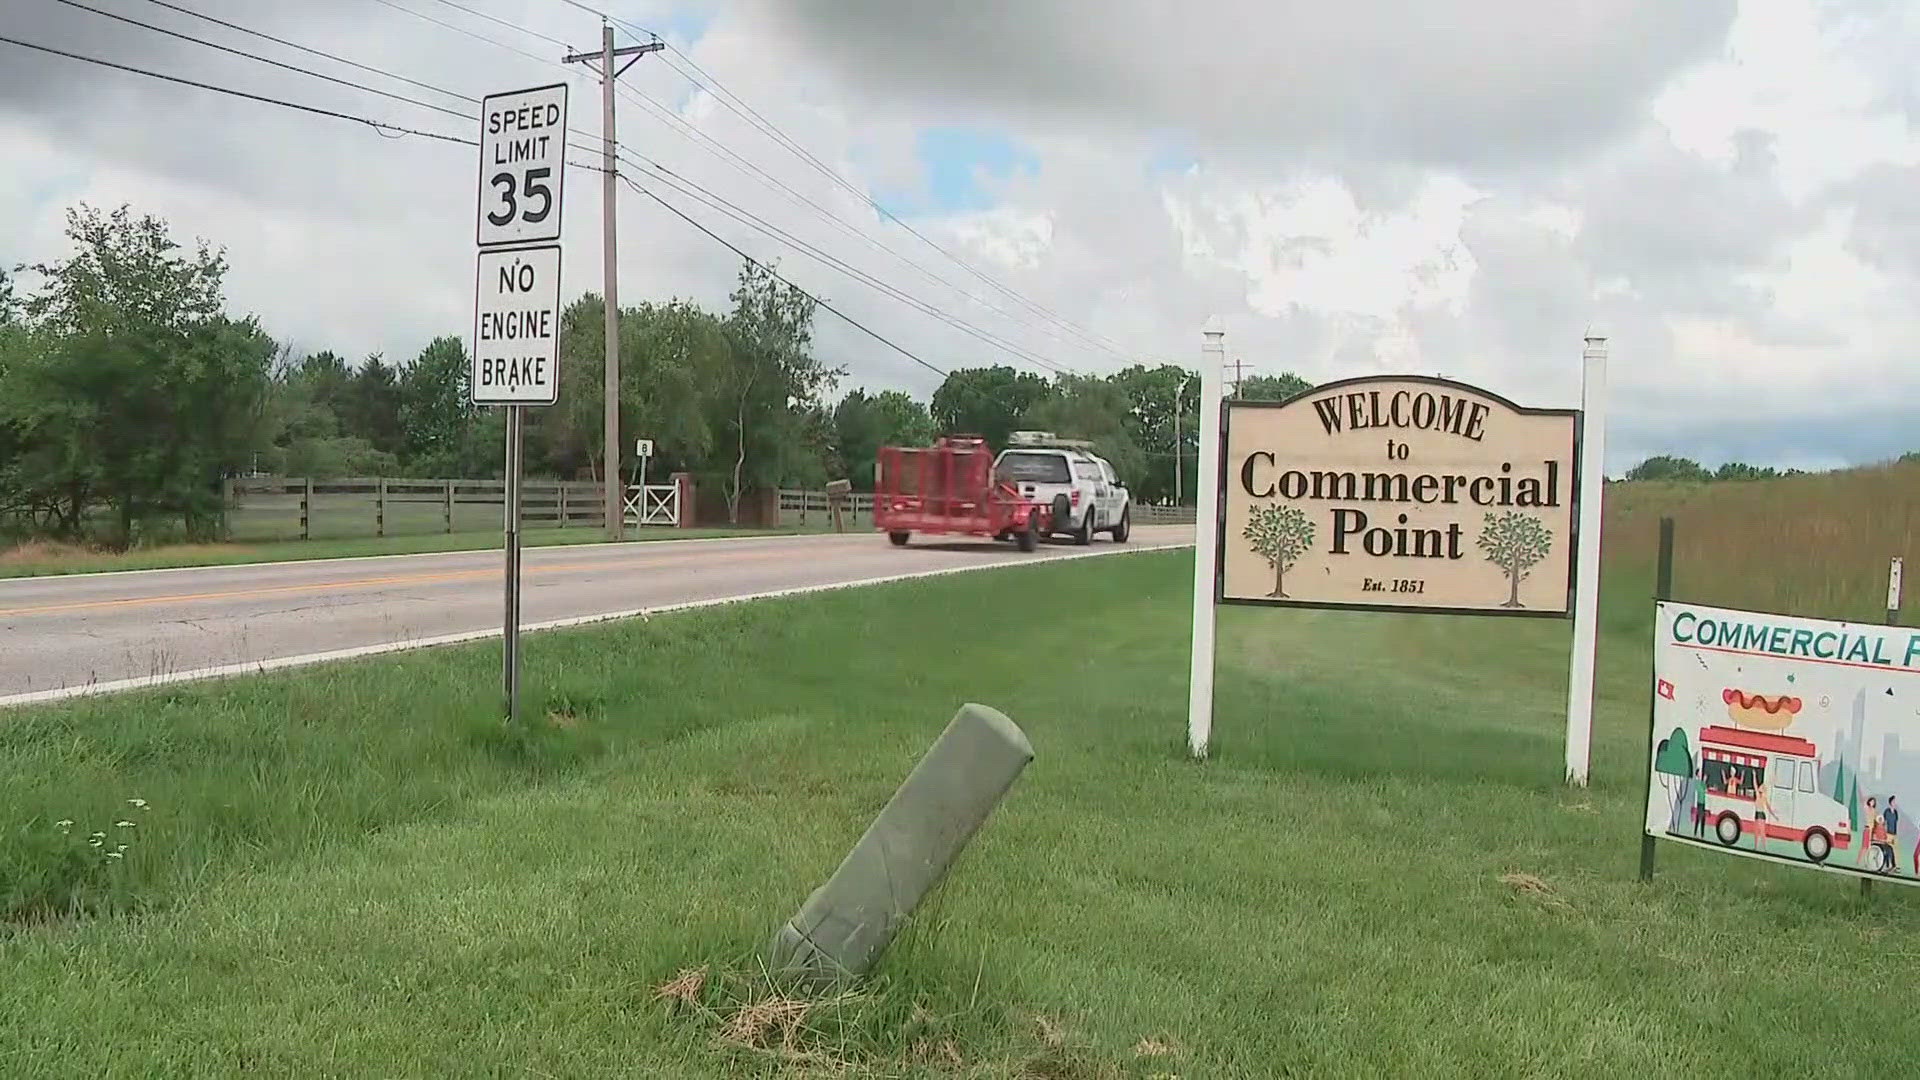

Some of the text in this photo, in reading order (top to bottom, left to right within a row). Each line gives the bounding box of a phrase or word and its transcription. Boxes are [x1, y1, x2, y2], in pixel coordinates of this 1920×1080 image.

[488, 103, 560, 134] SPEED
[495, 136, 550, 164] LIMIT
[487, 167, 552, 226] 35
[499, 264, 534, 294] NO
[481, 309, 551, 340] ENGINE
[482, 357, 546, 386] BRAKE
[1312, 390, 1490, 442] WELCOME
[1387, 439, 1409, 460] to
[1241, 450, 1560, 507] Commercial
[1328, 508, 1464, 560] Point
[1362, 577, 1425, 594] Est. 1851
[1672, 611, 1891, 664] COMMERCIAL
